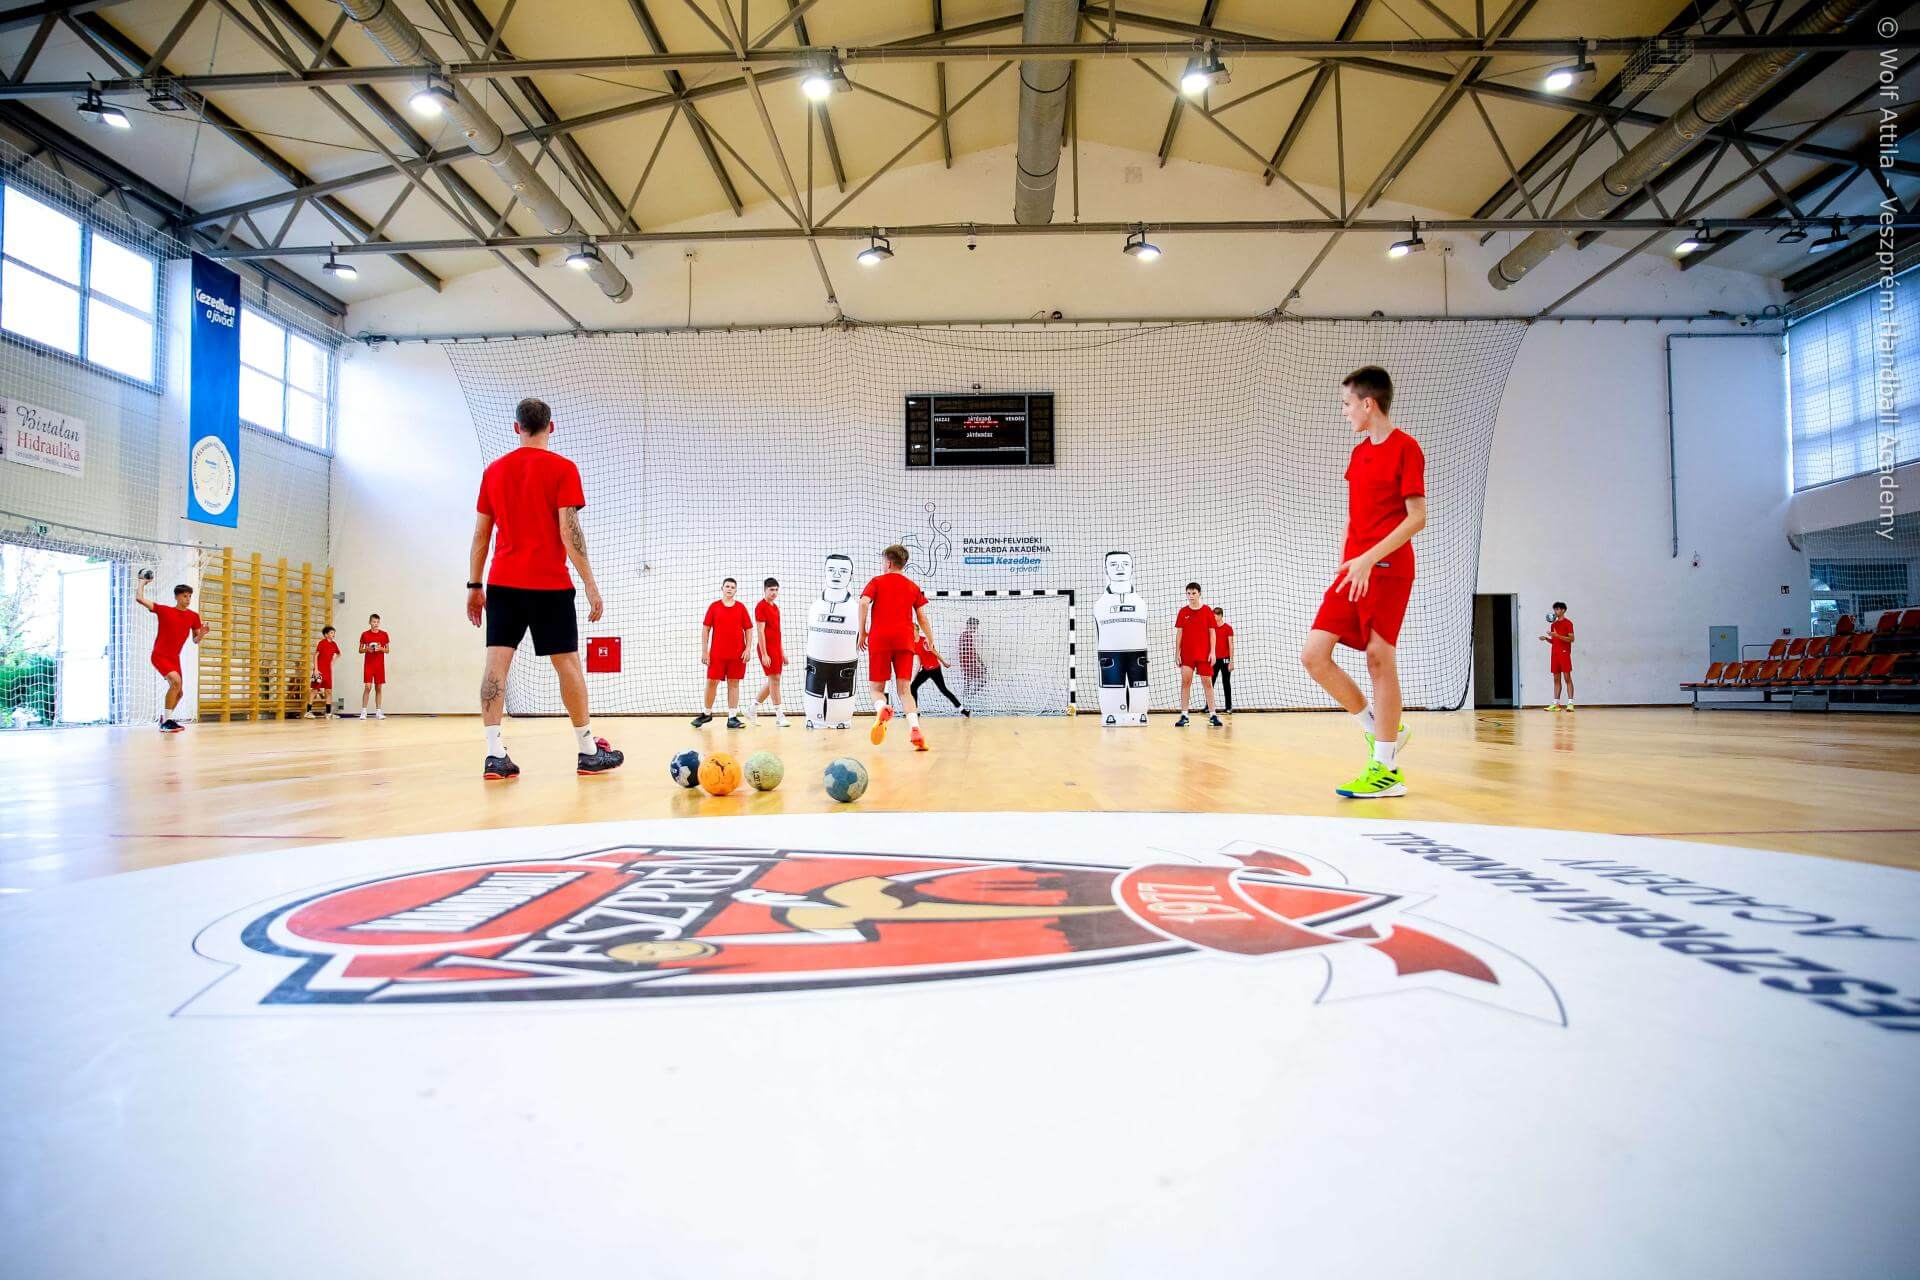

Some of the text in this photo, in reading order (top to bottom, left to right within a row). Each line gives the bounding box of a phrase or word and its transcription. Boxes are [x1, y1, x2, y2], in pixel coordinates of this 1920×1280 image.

[16, 405, 80, 442] Birtalan
[17, 430, 80, 462] Hidraulika
[963, 536, 1042, 545] BALATON-FELVIDÉKI
[1009, 545, 1051, 553] AKADÉMIA
[995, 556, 1041, 565] Kezedben
[1360, 831, 1590, 893] HANDBALL
[1541, 857, 1918, 941] ACADEMY
